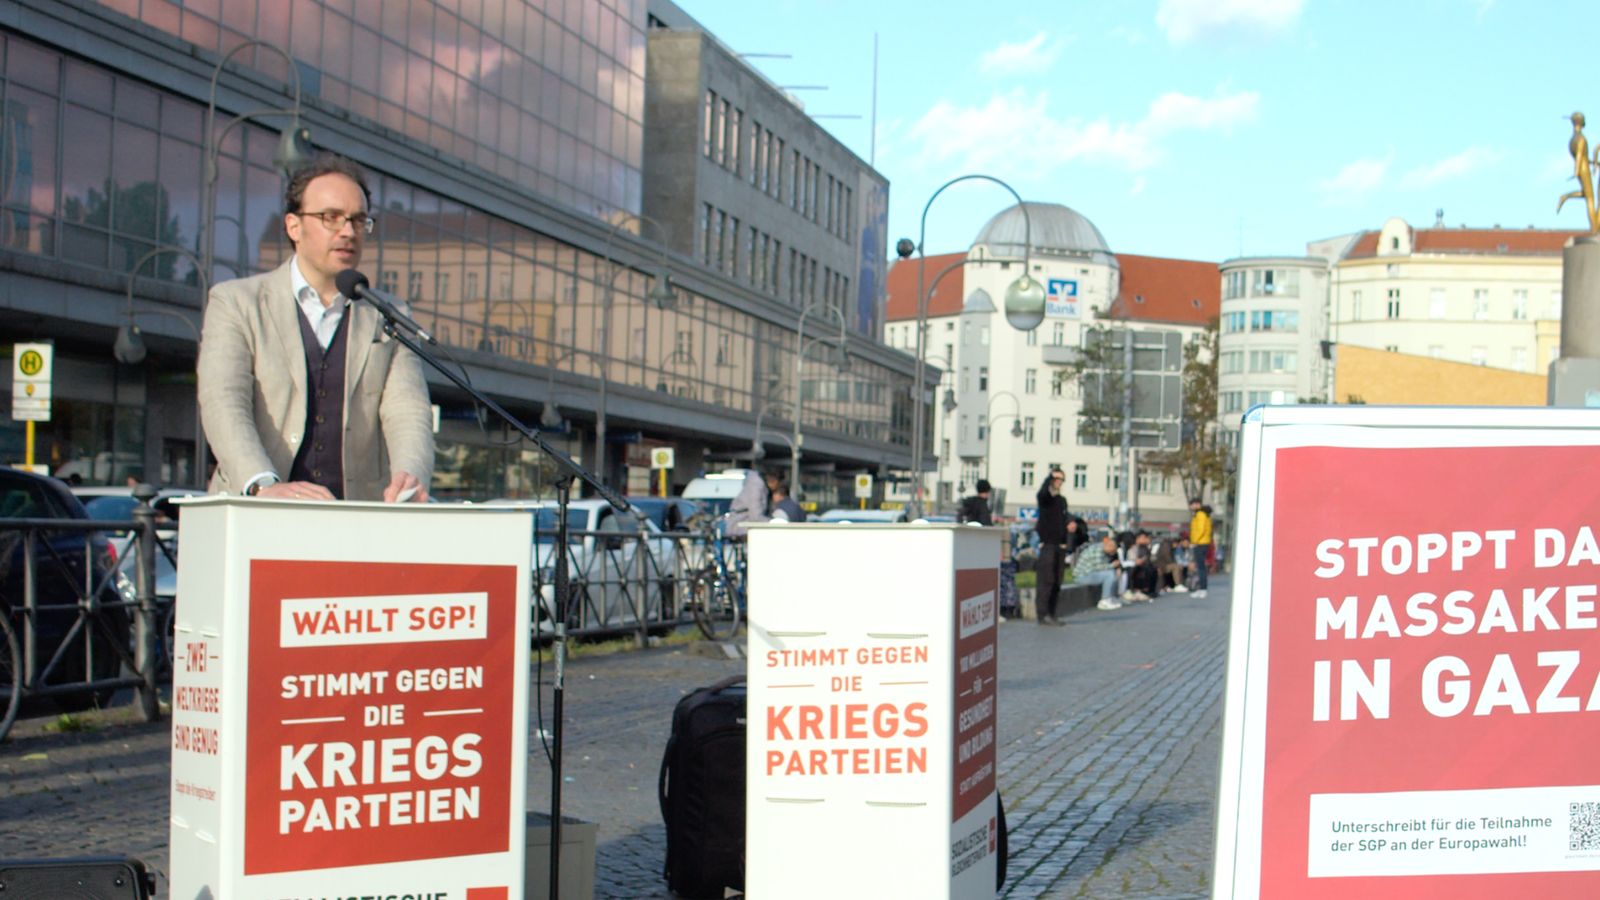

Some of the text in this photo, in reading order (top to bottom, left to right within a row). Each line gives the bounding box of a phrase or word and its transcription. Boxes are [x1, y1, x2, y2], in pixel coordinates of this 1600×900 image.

[1047, 302, 1076, 314] Bank
[1314, 526, 1600, 578] STOPPT DA
[292, 603, 476, 635] WÄHLT SGP!
[1315, 584, 1598, 640] MASSAKE
[186, 642, 208, 672] ZWEI
[767, 646, 928, 668] STIMMT GEGEN
[281, 666, 483, 699] STIMMT GEGEN
[831, 676, 862, 692] DIE
[1313, 650, 1600, 721] IN GAZ
[176, 686, 219, 713] WELTKRIEGE
[364, 704, 405, 727] DIE
[767, 702, 929, 741] KRIEGS
[175, 724, 218, 755] SIND GENUG
[280, 733, 483, 791] KRIEGS
[767, 747, 927, 776] PARTEIEN
[279, 786, 481, 835] PARTEIEN
[1331, 816, 1553, 833] Unterschreibt für die Teilnahme
[1331, 835, 1527, 852] der SGP an der Europawahl!
